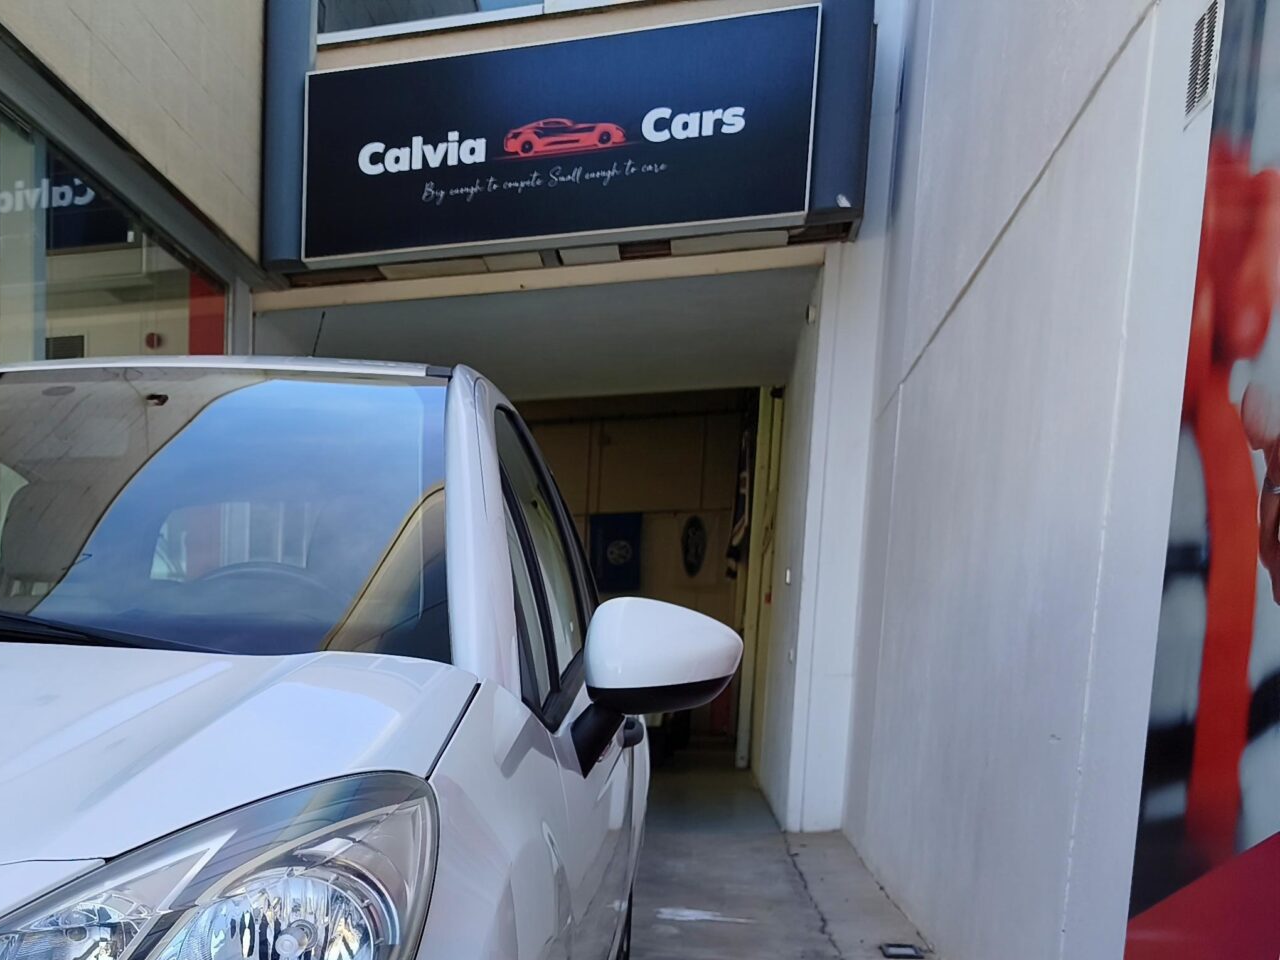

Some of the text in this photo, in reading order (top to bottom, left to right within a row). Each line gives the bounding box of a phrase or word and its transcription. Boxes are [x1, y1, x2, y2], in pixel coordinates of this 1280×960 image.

[358, 106, 746, 175] Calvia Cars
[422, 159, 668, 205] Big enough to compete Small enough to care
